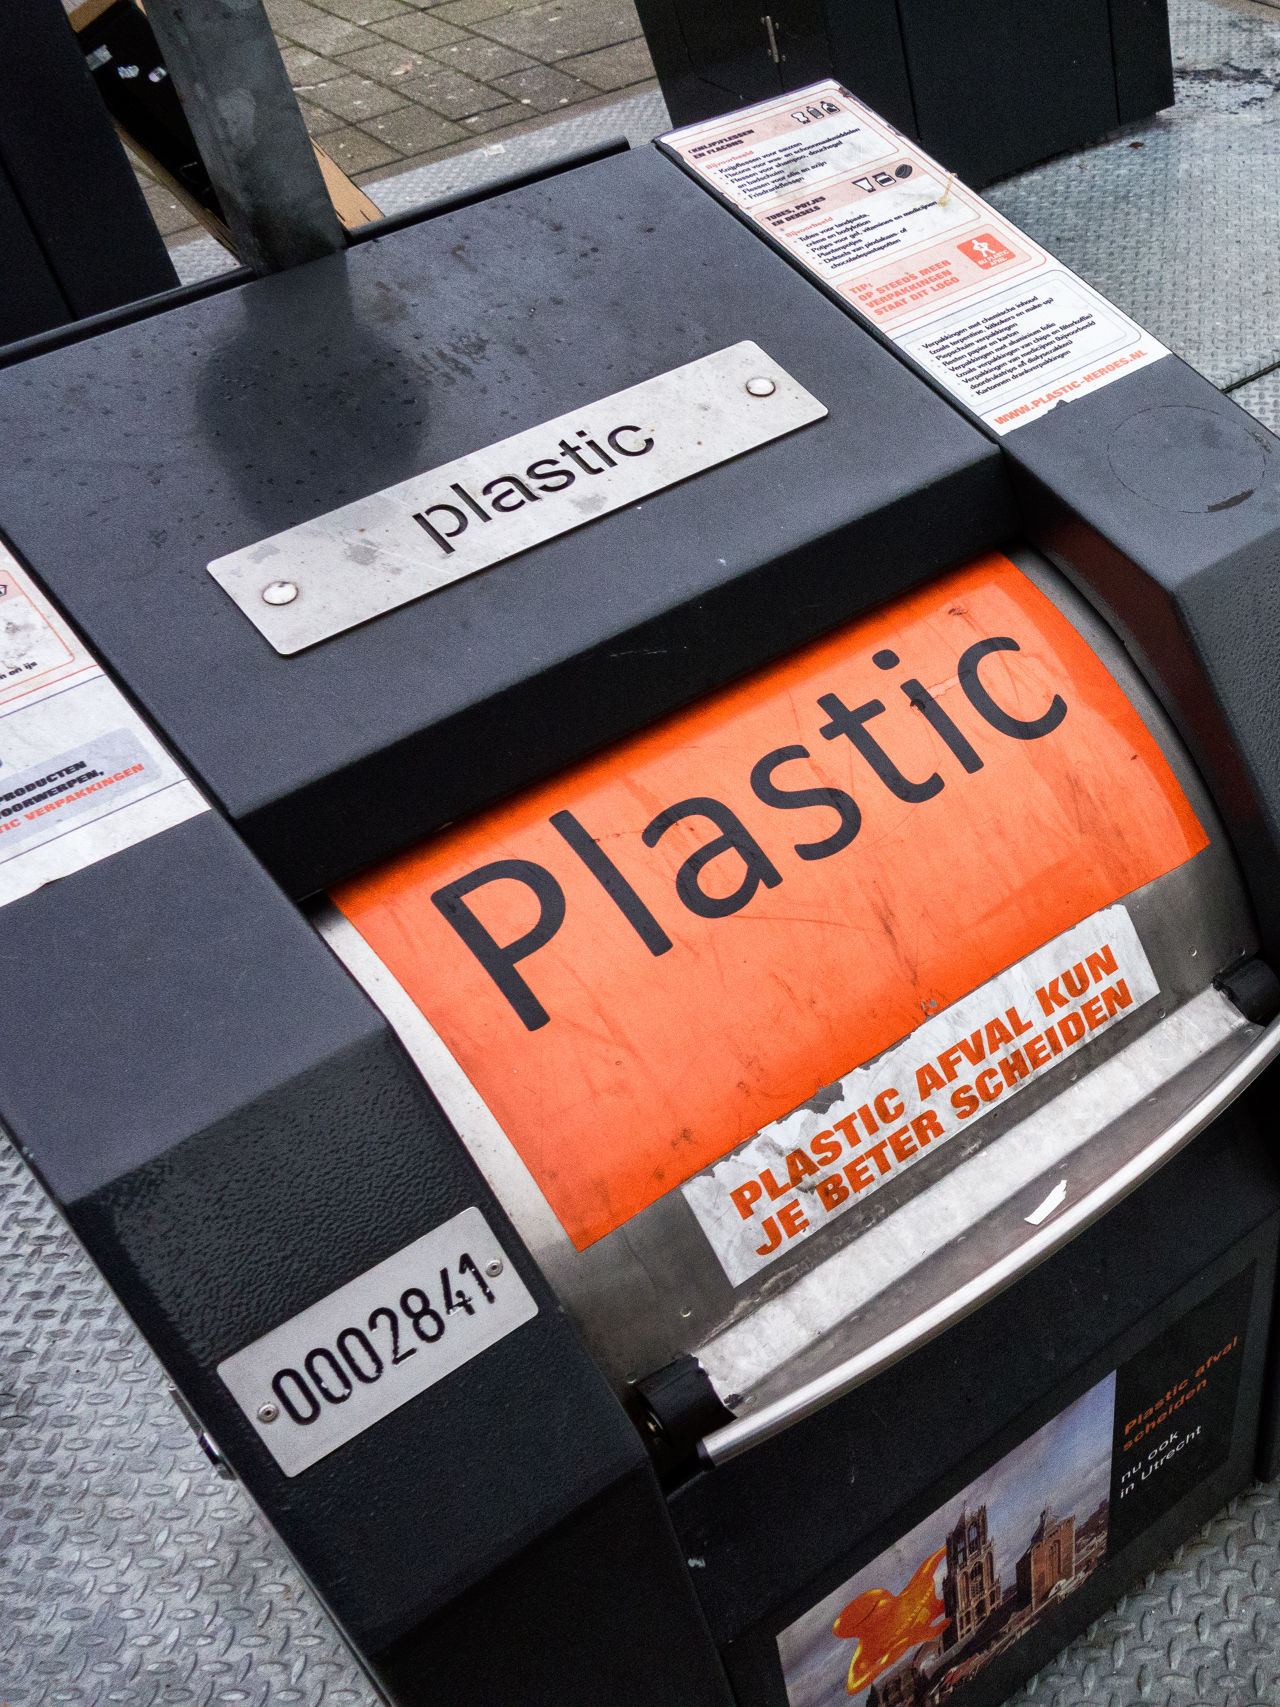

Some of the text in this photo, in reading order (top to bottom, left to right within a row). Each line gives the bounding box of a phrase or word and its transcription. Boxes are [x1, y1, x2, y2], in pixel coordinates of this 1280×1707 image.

[730, 172, 758, 183] Flessen
[742, 182, 770, 194] Flessen
[784, 205, 820, 221] DEKSELS
[794, 196, 826, 210] POTJES
[784, 216, 833, 237] Bijvoorbeeld
[797, 232, 819, 242] Tubes
[810, 242, 833, 253] Potjes
[862, 218, 893, 232] vitamines
[835, 220, 871, 235] bodylotion
[817, 239, 862, 258] Plantenpotjes
[823, 251, 851, 263] Deksels
[866, 269, 952, 308] VERPAKKINGEN
[876, 273, 918, 294] STEEDS
[874, 298, 908, 315] STAAT
[921, 328, 967, 348] Verpakkingen
[981, 306, 1016, 323] chemische
[1015, 295, 1038, 308] inhoud
[928, 344, 950, 355] (zoals
[949, 329, 986, 346] terpentine,
[984, 315, 1015, 330] kitkokers
[935, 322, 1018, 360] Piepschuim verpakkingen
[941, 354, 967, 366] Resten
[967, 344, 988, 357] papier
[996, 330, 1019, 342] karton
[948, 350, 994, 372] Verpakkingen
[1008, 329, 1041, 346] aluminium
[1039, 322, 1056, 331] folie
[955, 367, 977, 378] (zoals
[977, 347, 1020, 368] verpakkingen
[1032, 333, 1051, 343] chips
[961, 362, 1007, 383] Verpakkingen
[1020, 340, 1055, 357] medicijnen
[970, 366, 1017, 389] doordrukstrips
[975, 350, 1071, 395] Kartonnen drankverpakkingen
[994, 350, 1146, 424] WWW.PLASTIC-HEROES.NL
[412, 425, 654, 553] plastic
[0, 769, 104, 819] OORWERPEN,
[24, 763, 144, 821] VERPAKKINGEN
[431, 636, 1068, 1031] Plastic
[729, 944, 1119, 1220] PLASTIC AFVAL KUN
[755, 978, 1133, 1256] JE BETER SCHEIDEN
[272, 1253, 496, 1425] 0002841
[1125, 1336, 1238, 1435] Plastic afval
[1123, 1379, 1207, 1451] scheiden
[1120, 1425, 1202, 1499] in Utrecht
[1122, 1431, 1178, 1484] nu ook
